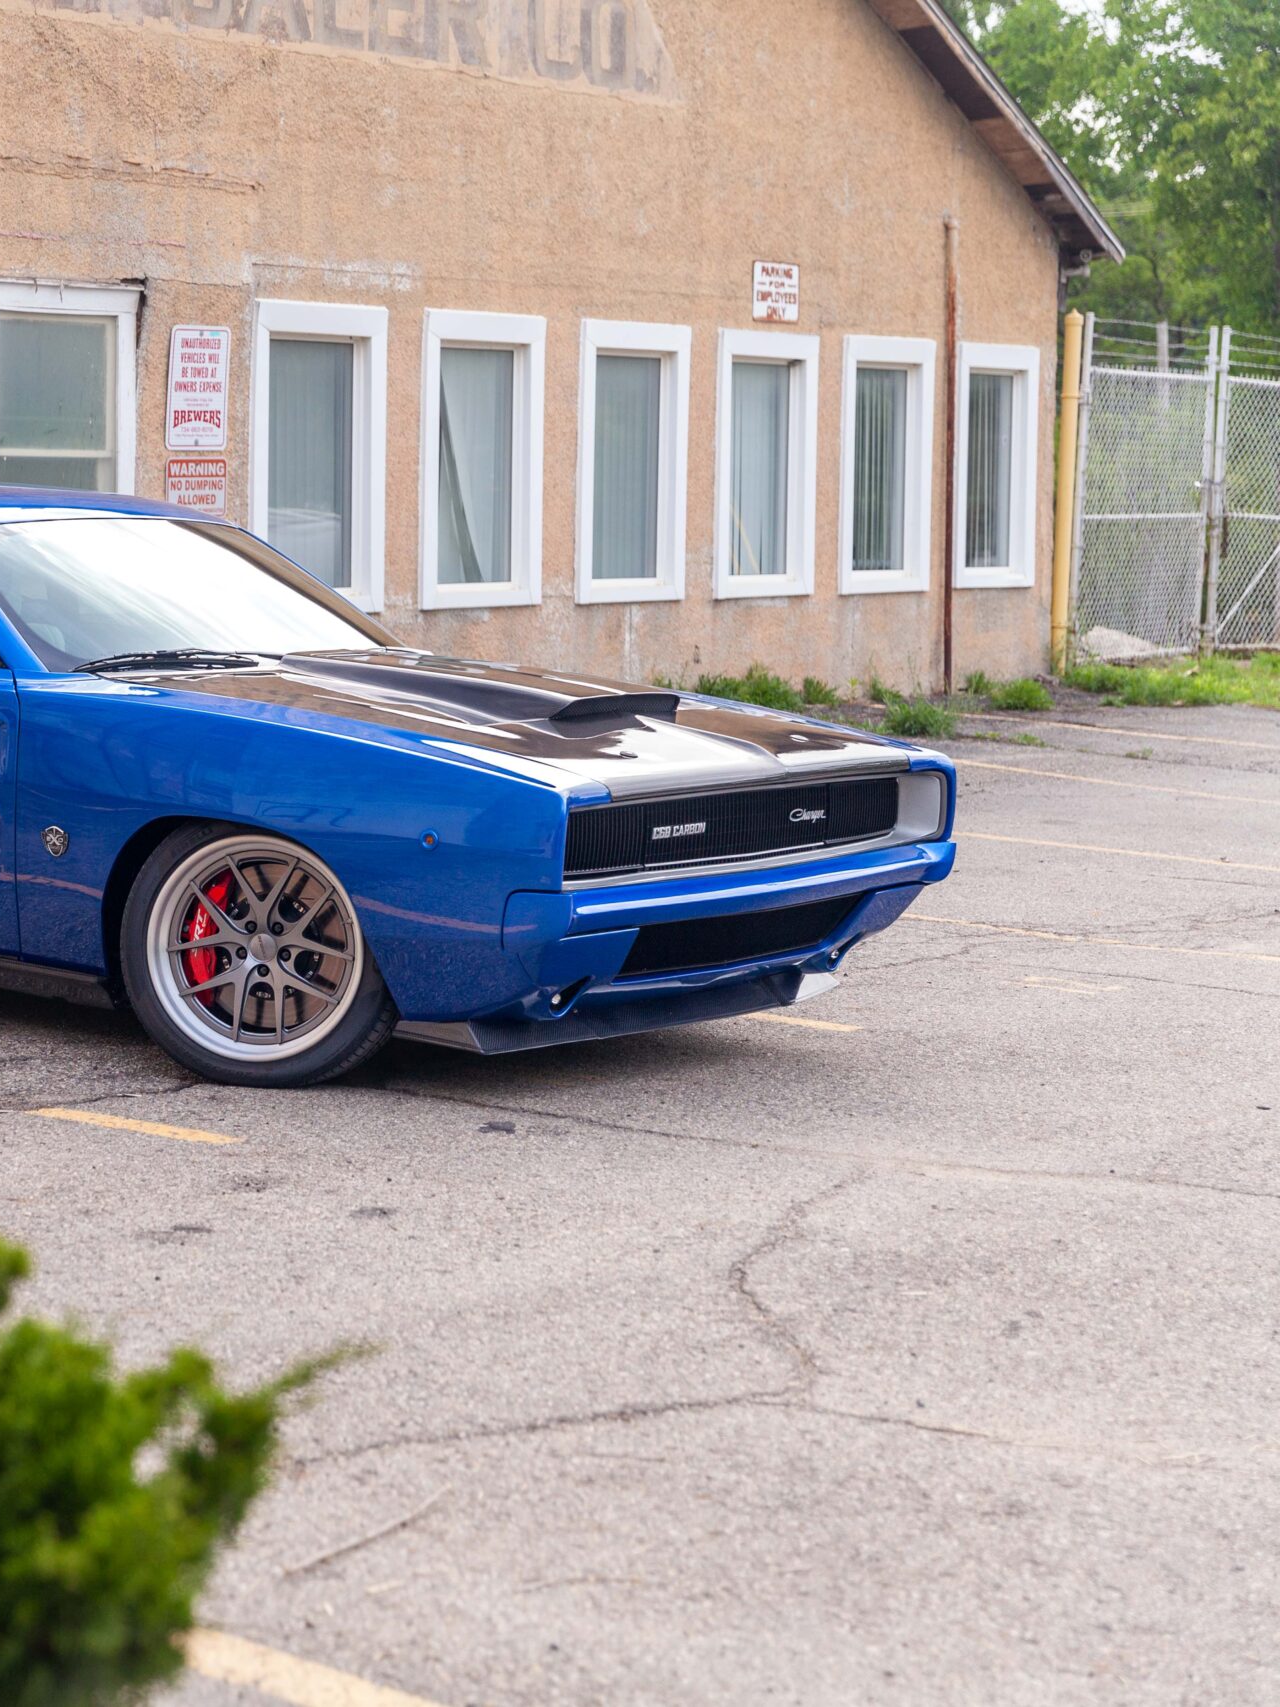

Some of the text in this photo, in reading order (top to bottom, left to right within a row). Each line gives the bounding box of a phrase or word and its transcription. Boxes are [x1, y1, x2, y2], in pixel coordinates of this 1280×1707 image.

[761, 265, 793, 280] PARKING
[768, 281, 785, 289] FOR
[756, 290, 797, 305] EMPLOYEES
[766, 305, 786, 320] ONLY
[180, 337, 221, 350] UNAUTHORIZED
[180, 352, 220, 364] VEHICLES WILL
[181, 366, 217, 379] BE TOWED AT
[174, 381, 222, 393] OWNERS EXPENSE
[169, 462, 225, 476] WARNING
[170, 479, 224, 491] NO DUMPING
[177, 493, 217, 505] ALLOWED
[789, 808, 826, 823] Charger
[672, 822, 706, 837] CARBON
